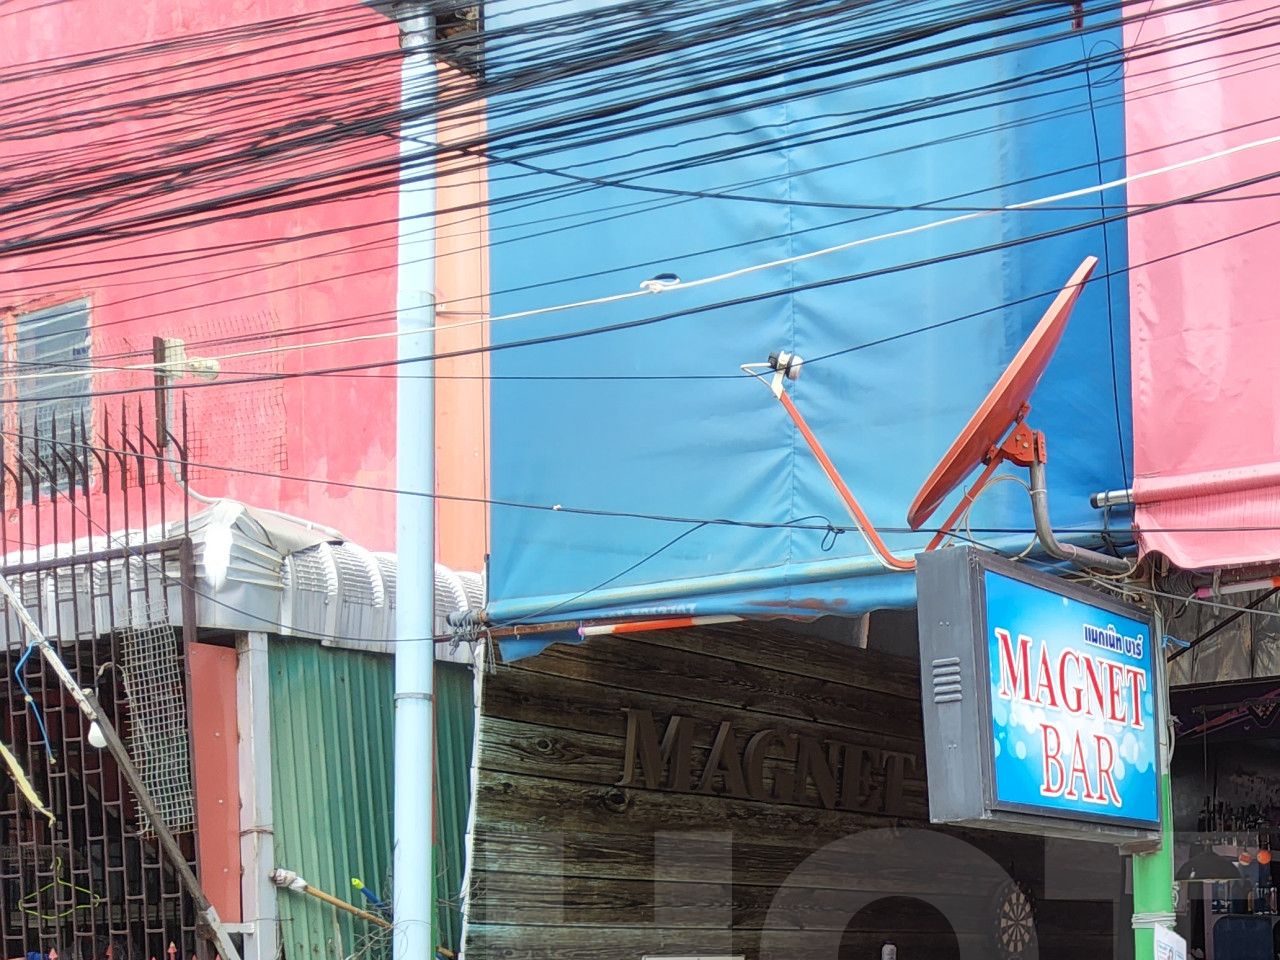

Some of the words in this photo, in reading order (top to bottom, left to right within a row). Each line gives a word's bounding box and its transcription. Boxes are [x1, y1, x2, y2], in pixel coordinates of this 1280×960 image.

[996, 630, 1145, 727] MAGNET
[614, 706, 917, 815] MAGNET
[1039, 722, 1121, 806] BAR
